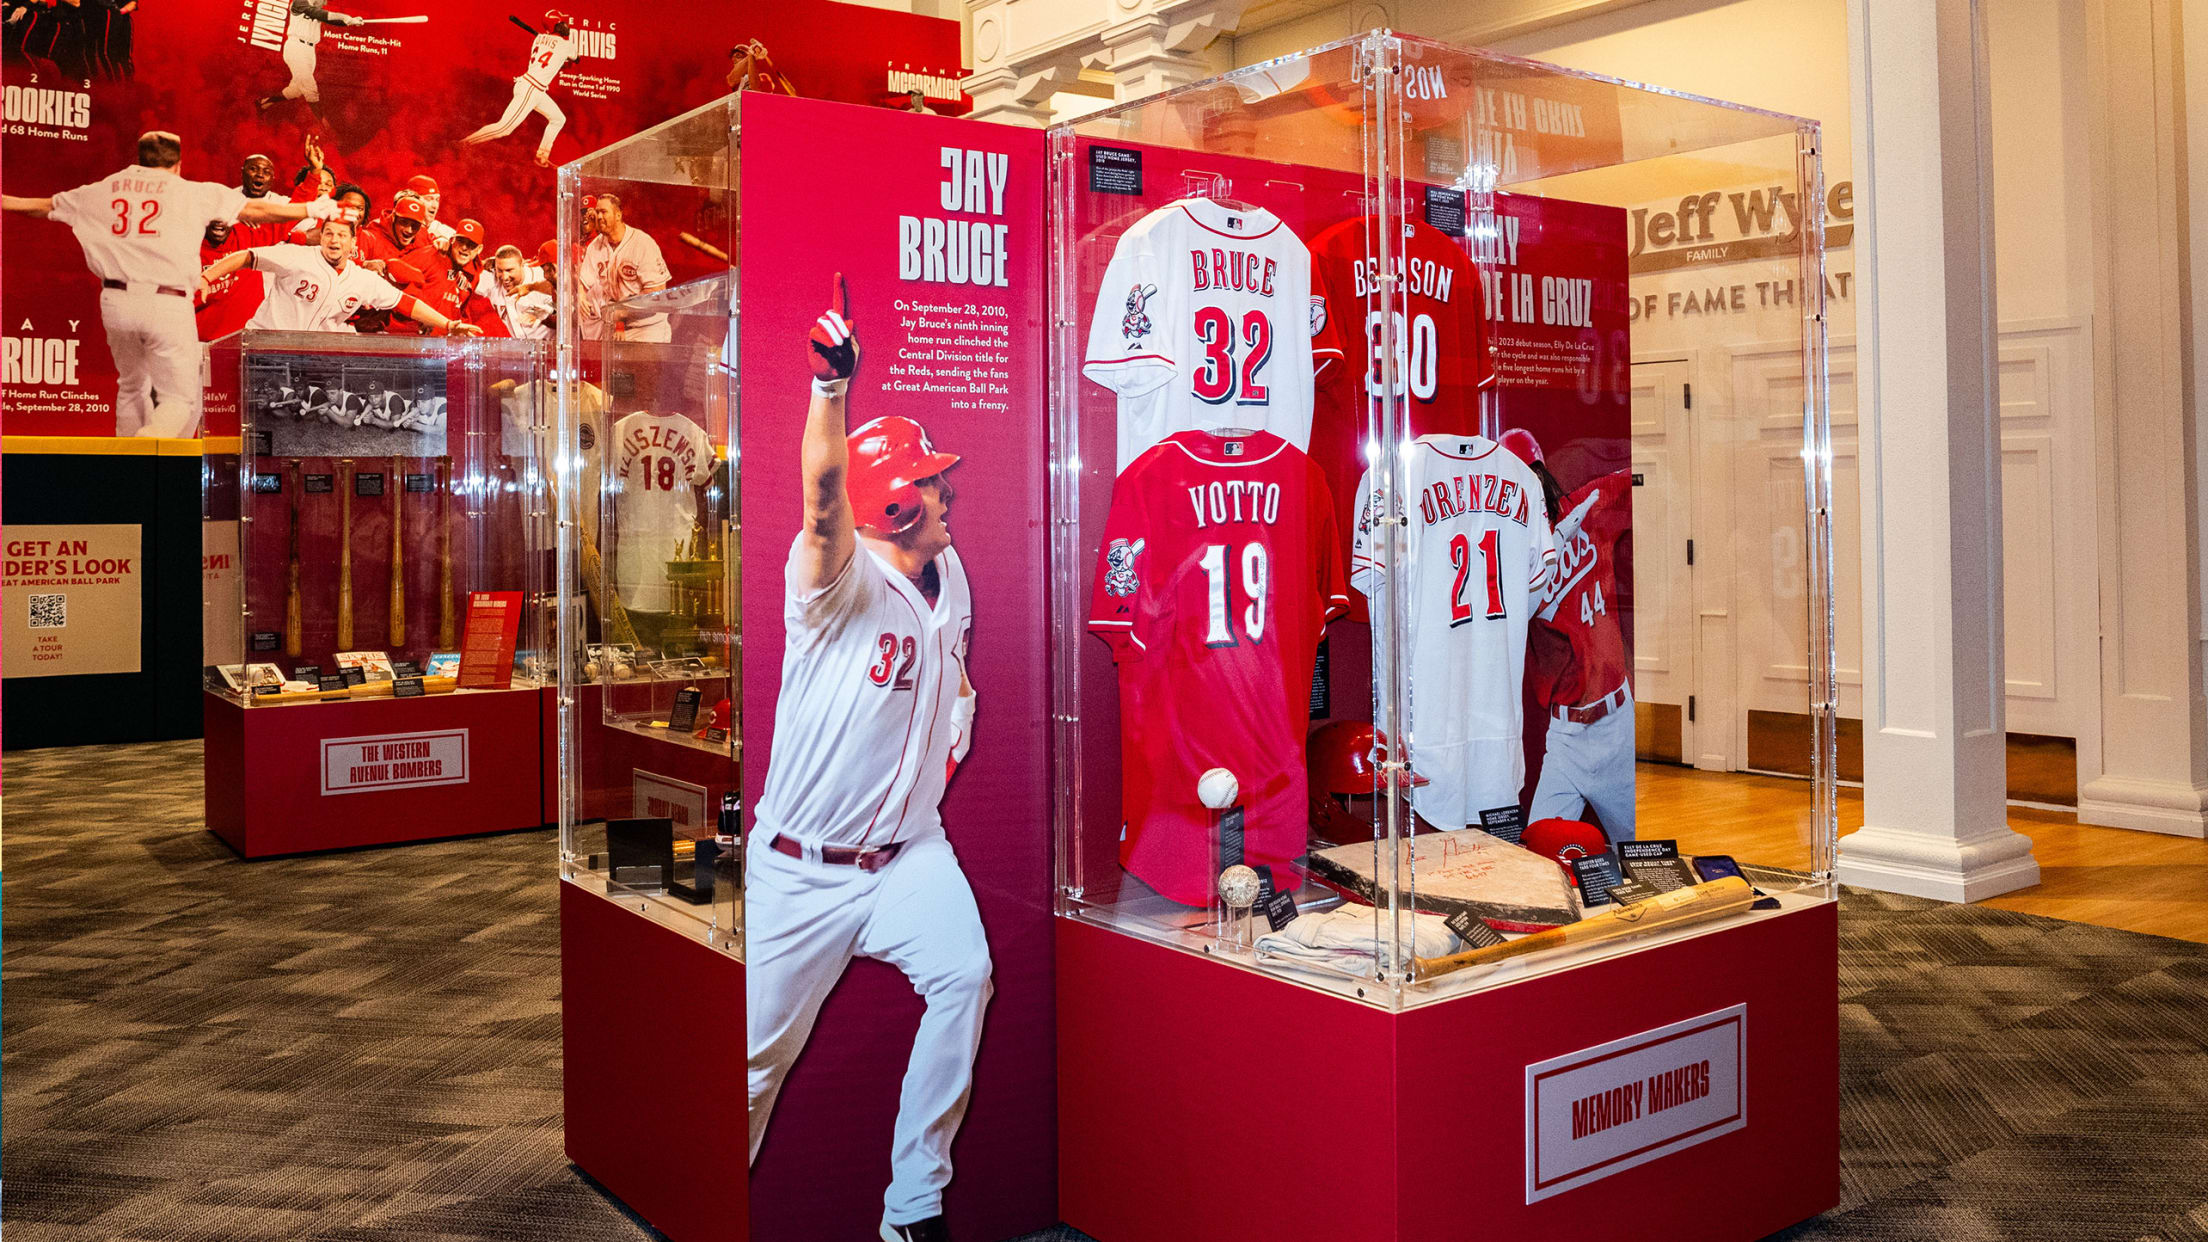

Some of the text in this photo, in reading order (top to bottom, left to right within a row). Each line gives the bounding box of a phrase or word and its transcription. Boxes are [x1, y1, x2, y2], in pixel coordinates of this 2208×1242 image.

[250, 0, 290, 51] LYNC
[569, 17, 616, 30] ERIC
[324, 30, 401, 48] Most Career Pinch-Hit
[338, 42, 359, 51] Home
[360, 45, 380, 56] Runs,
[569, 28, 616, 60] DAVIS
[887, 70, 962, 102] MCCORMICK
[10, 125, 25, 135] 68
[28, 126, 59, 139] Home
[62, 130, 88, 142] Runs
[112, 178, 168, 194] BRUCE
[941, 146, 1008, 216] JAY
[112, 198, 162, 239] 32
[1629, 191, 1722, 258] Jeff
[899, 215, 1008, 287] BRUCE
[1686, 247, 1728, 262] FAMILY
[1190, 248, 1277, 297] BRUCE
[294, 279, 320, 303] 23
[1511, 273, 1535, 324] LA
[1542, 276, 1593, 328] CRUZ
[894, 300, 1008, 319] On September 28, 2010,
[1630, 294, 1658, 321] OF
[1668, 285, 1746, 317] FAME
[900, 316, 1008, 336] Jay Bruce's ninth inning
[908, 333, 1008, 348] home run clinched the
[1499, 337, 1514, 346] 2023
[1515, 338, 1532, 347] debut
[899, 348, 1008, 363] Central Division title for
[1191, 306, 1273, 406] 32
[889, 365, 1008, 381] the Reds, sending the fans
[8, 389, 37, 399] Home
[39, 390, 58, 399] Run
[60, 391, 99, 400] Clinches
[882, 381, 1008, 394] at Great American Ball Park
[16, 402, 110, 414] September 28, 2010
[951, 398, 969, 409] into
[979, 399, 1008, 412] frenzy.
[641, 455, 675, 491] 18
[1188, 480, 1280, 529] VOTTO
[1420, 474, 1529, 527] ORENZEN
[7, 540, 88, 557] GET AN
[2, 558, 131, 576] DER'S LOOK
[20, 577, 69, 587] AMERICAN
[71, 577, 94, 585] BALL
[96, 577, 120, 585] PARK
[1449, 528, 1507, 629] 21
[1200, 542, 1268, 648] 19
[1580, 580, 1606, 628] 44
[38, 635, 58, 643] TAKE
[40, 644, 63, 652] TOUR
[32, 653, 63, 661] TODAY!
[868, 632, 916, 691] 32
[362, 741, 430, 762] THE WESTERN
[350, 760, 442, 784] AVENUE BOMBERS
[1572, 1059, 1710, 1141] MEMORY MAKERS
